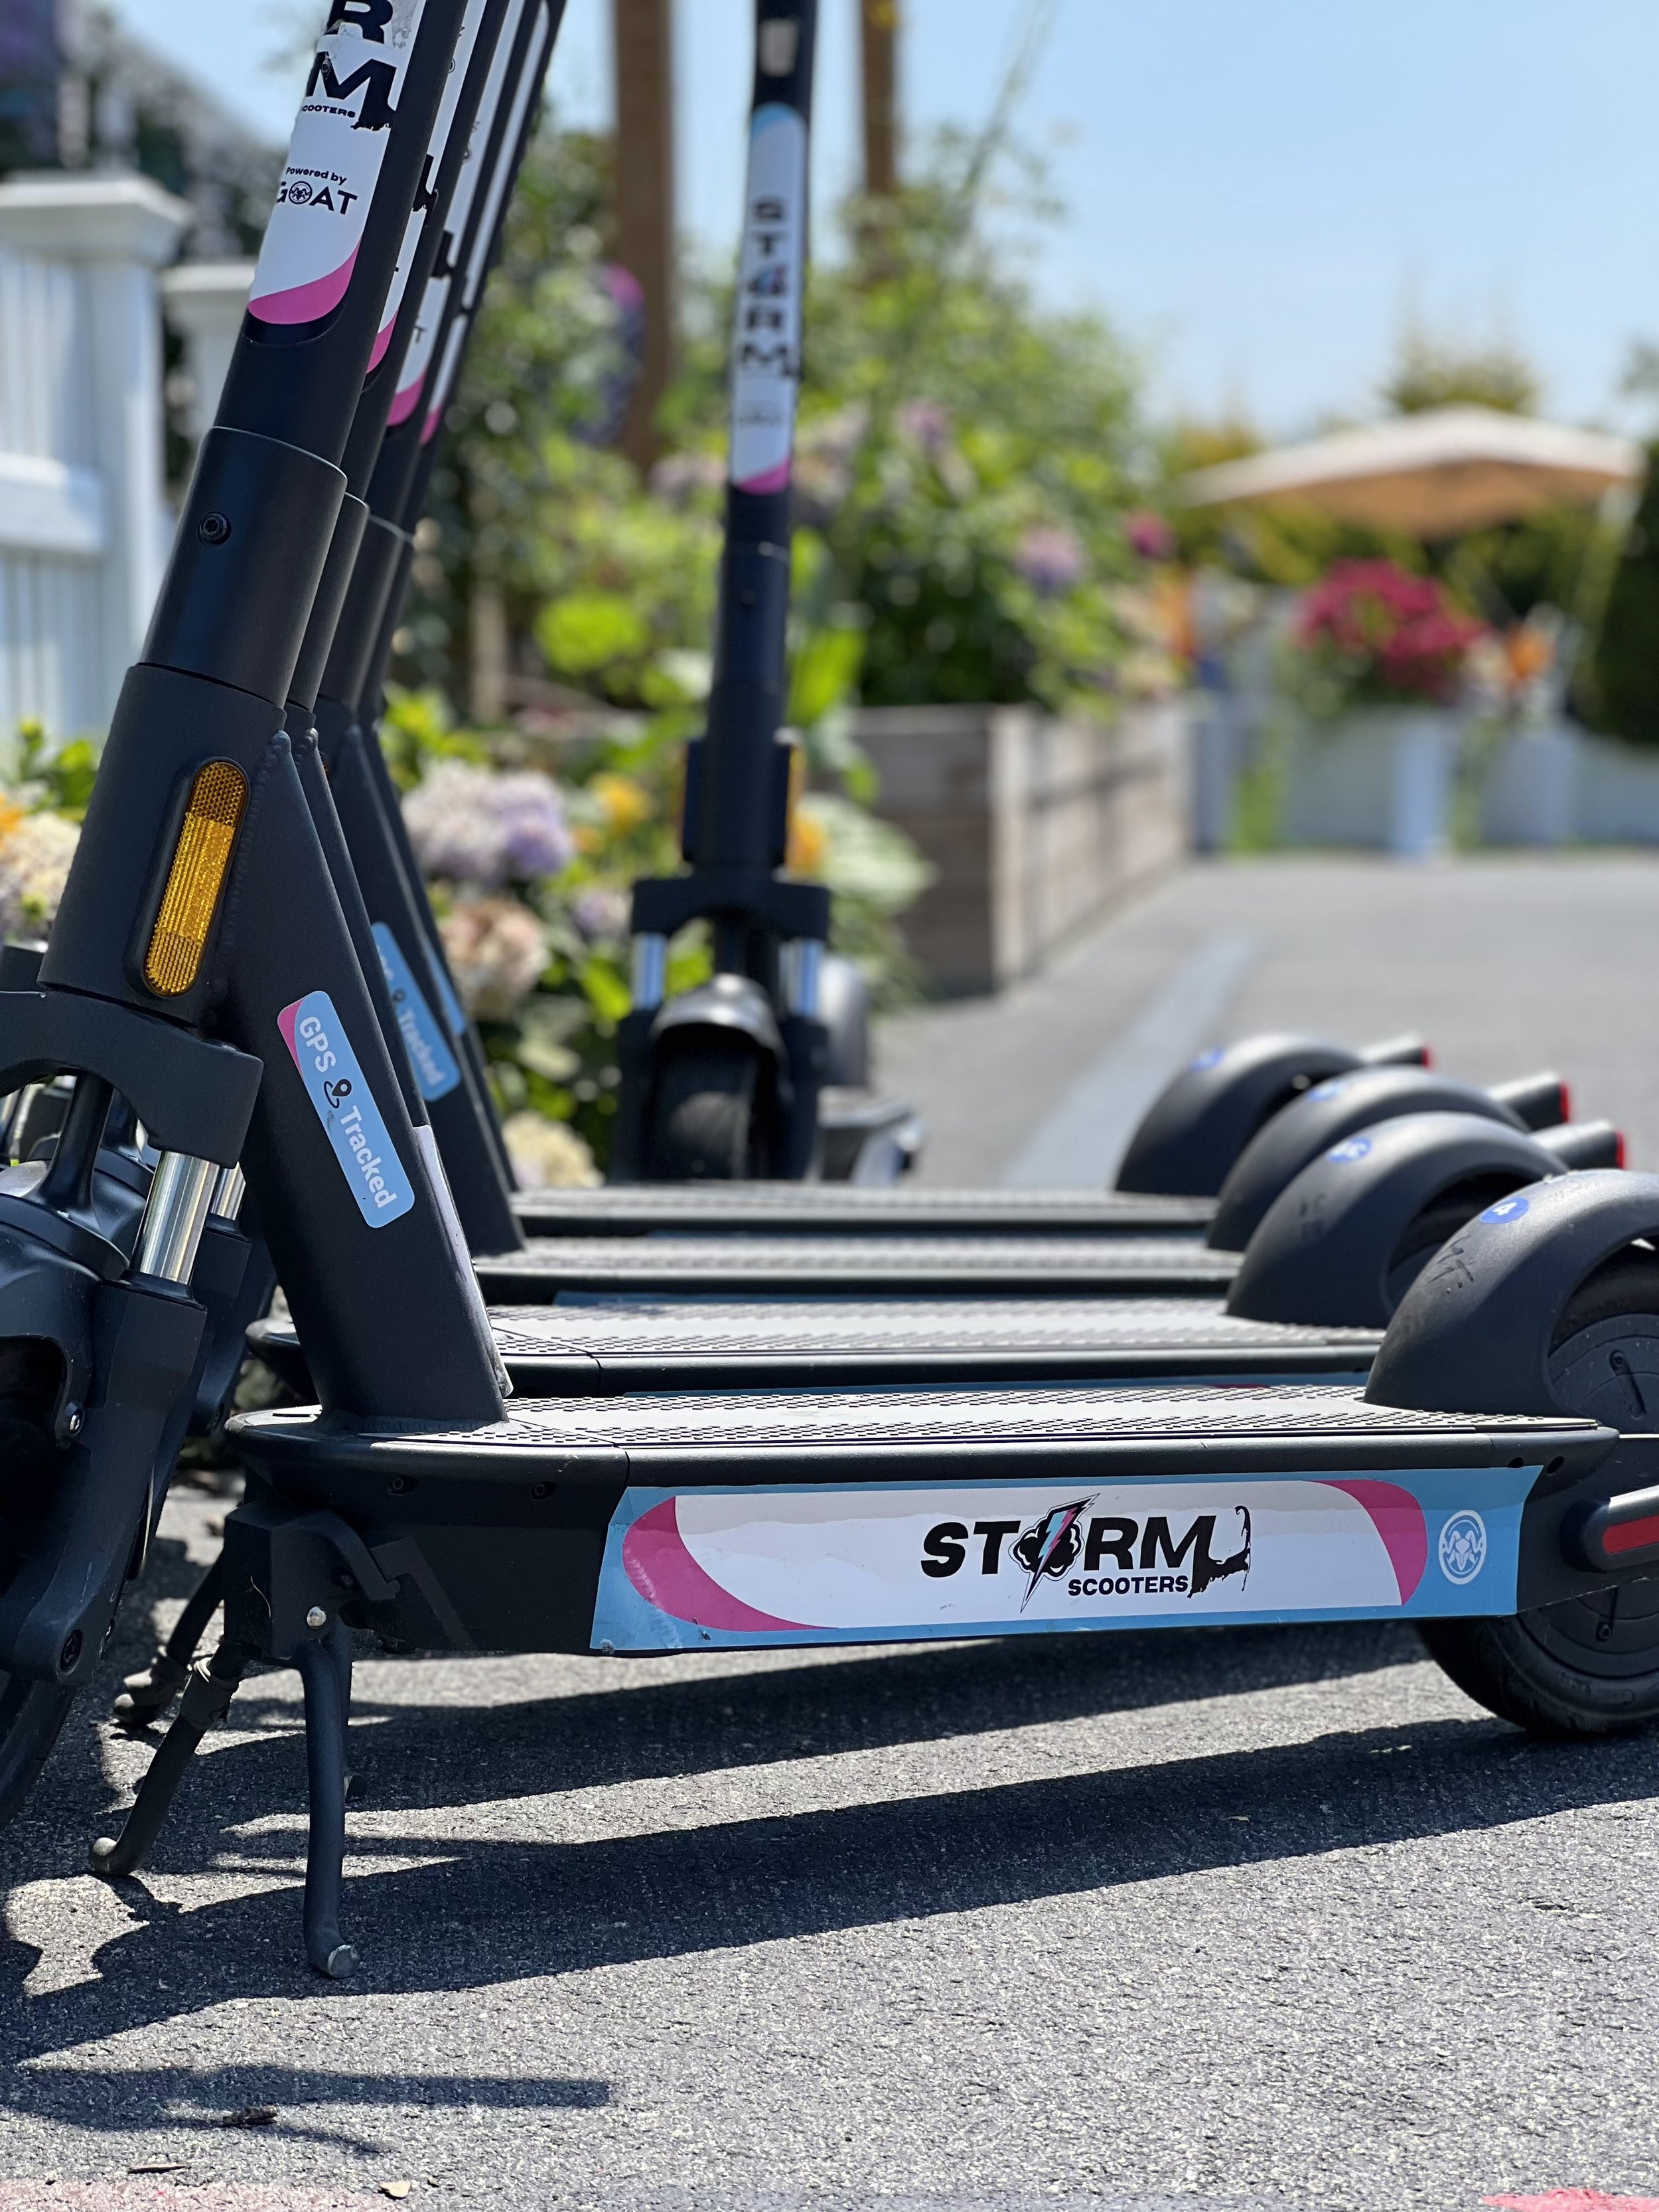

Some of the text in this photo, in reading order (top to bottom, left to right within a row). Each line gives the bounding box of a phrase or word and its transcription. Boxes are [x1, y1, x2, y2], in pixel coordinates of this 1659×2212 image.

[303, 105, 356, 118] COOTERS
[286, 167, 347, 186] Powered by
[299, 1016, 397, 1209] GPS Tracked
[920, 1503, 1251, 1598] STORM
[1068, 1575, 1189, 1596] SCOOTERS
